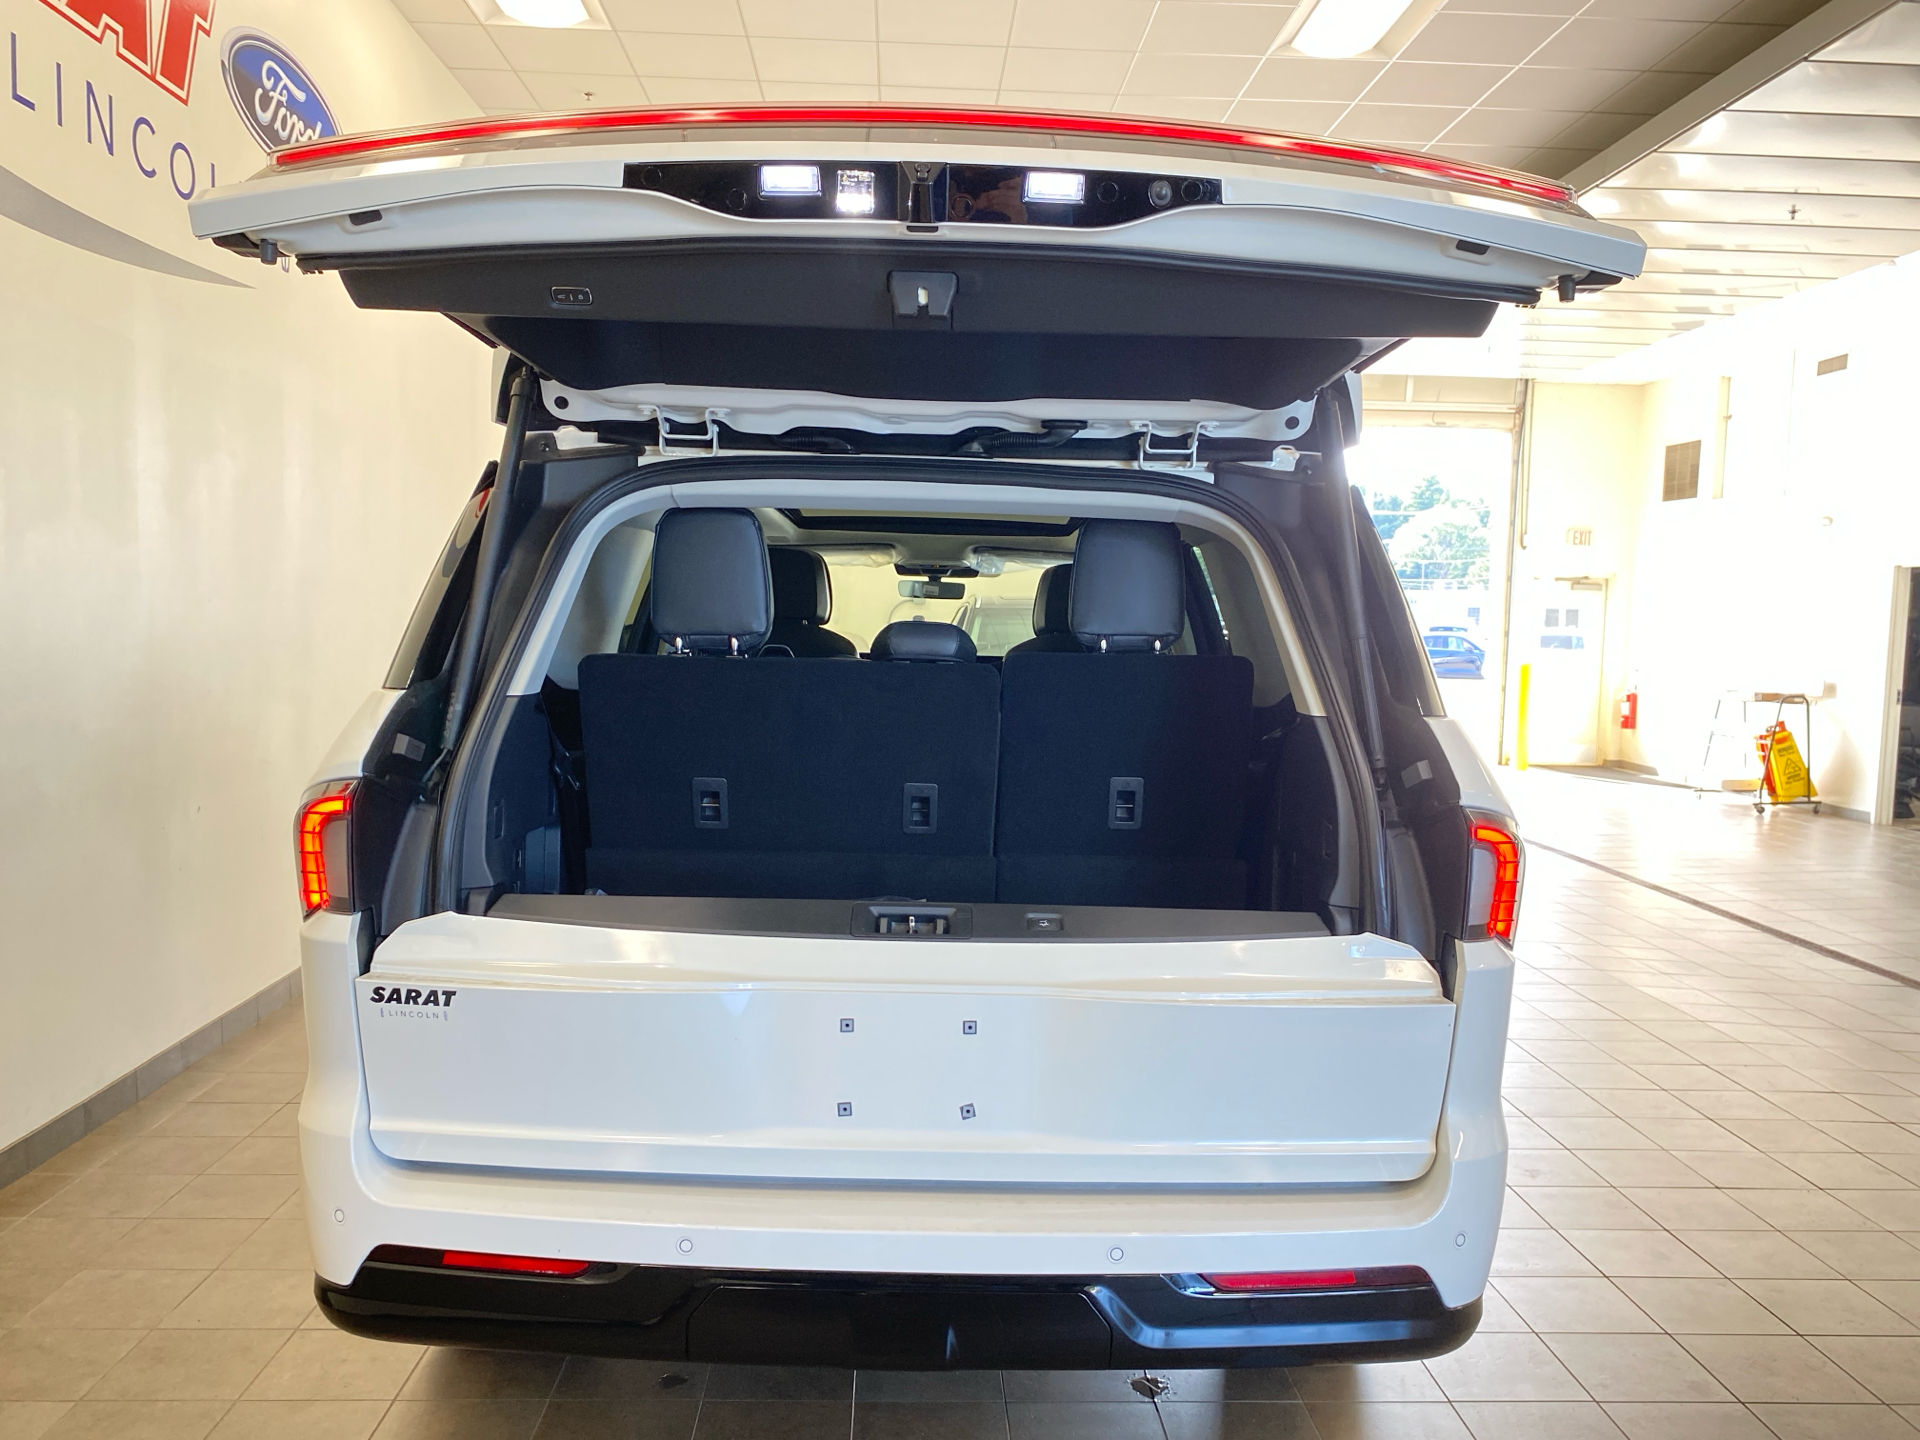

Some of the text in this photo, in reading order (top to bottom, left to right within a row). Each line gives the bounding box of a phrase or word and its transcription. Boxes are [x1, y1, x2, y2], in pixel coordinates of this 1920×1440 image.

[1572, 530, 1592, 546] EXIT
[370, 986, 457, 1007] SARAT
[388, 1009, 440, 1019] LINCOLN
